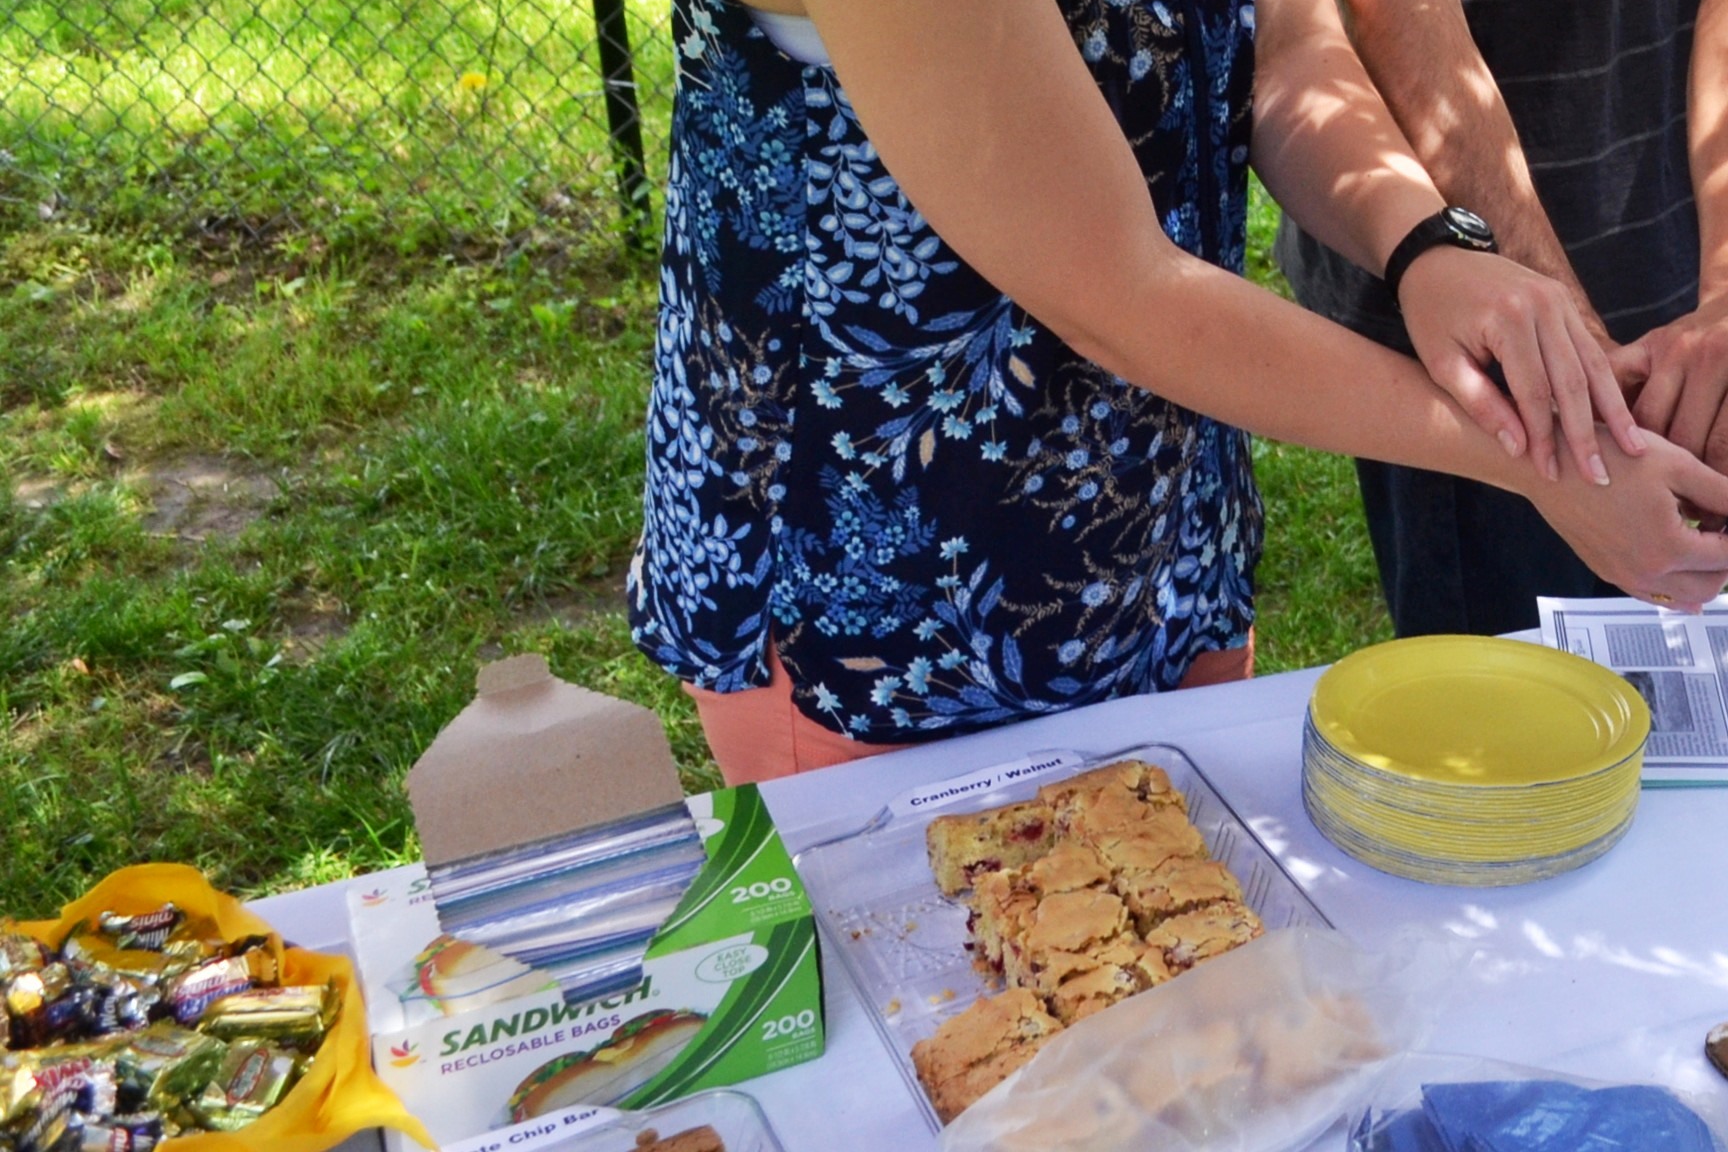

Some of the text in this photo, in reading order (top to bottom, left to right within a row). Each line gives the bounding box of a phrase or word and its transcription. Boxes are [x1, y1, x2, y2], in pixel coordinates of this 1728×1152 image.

[910, 777, 992, 807] Cranberry
[1005, 758, 1063, 779] Walnut
[730, 877, 792, 904] 200
[714, 956, 752, 973] CLOSE
[716, 948, 748, 963] EASY
[722, 965, 747, 979] TOP
[762, 1009, 815, 1041] 200
[441, 1013, 622, 1075] RECLOSABLE BAGS
[508, 1108, 600, 1144] Chip Bar
